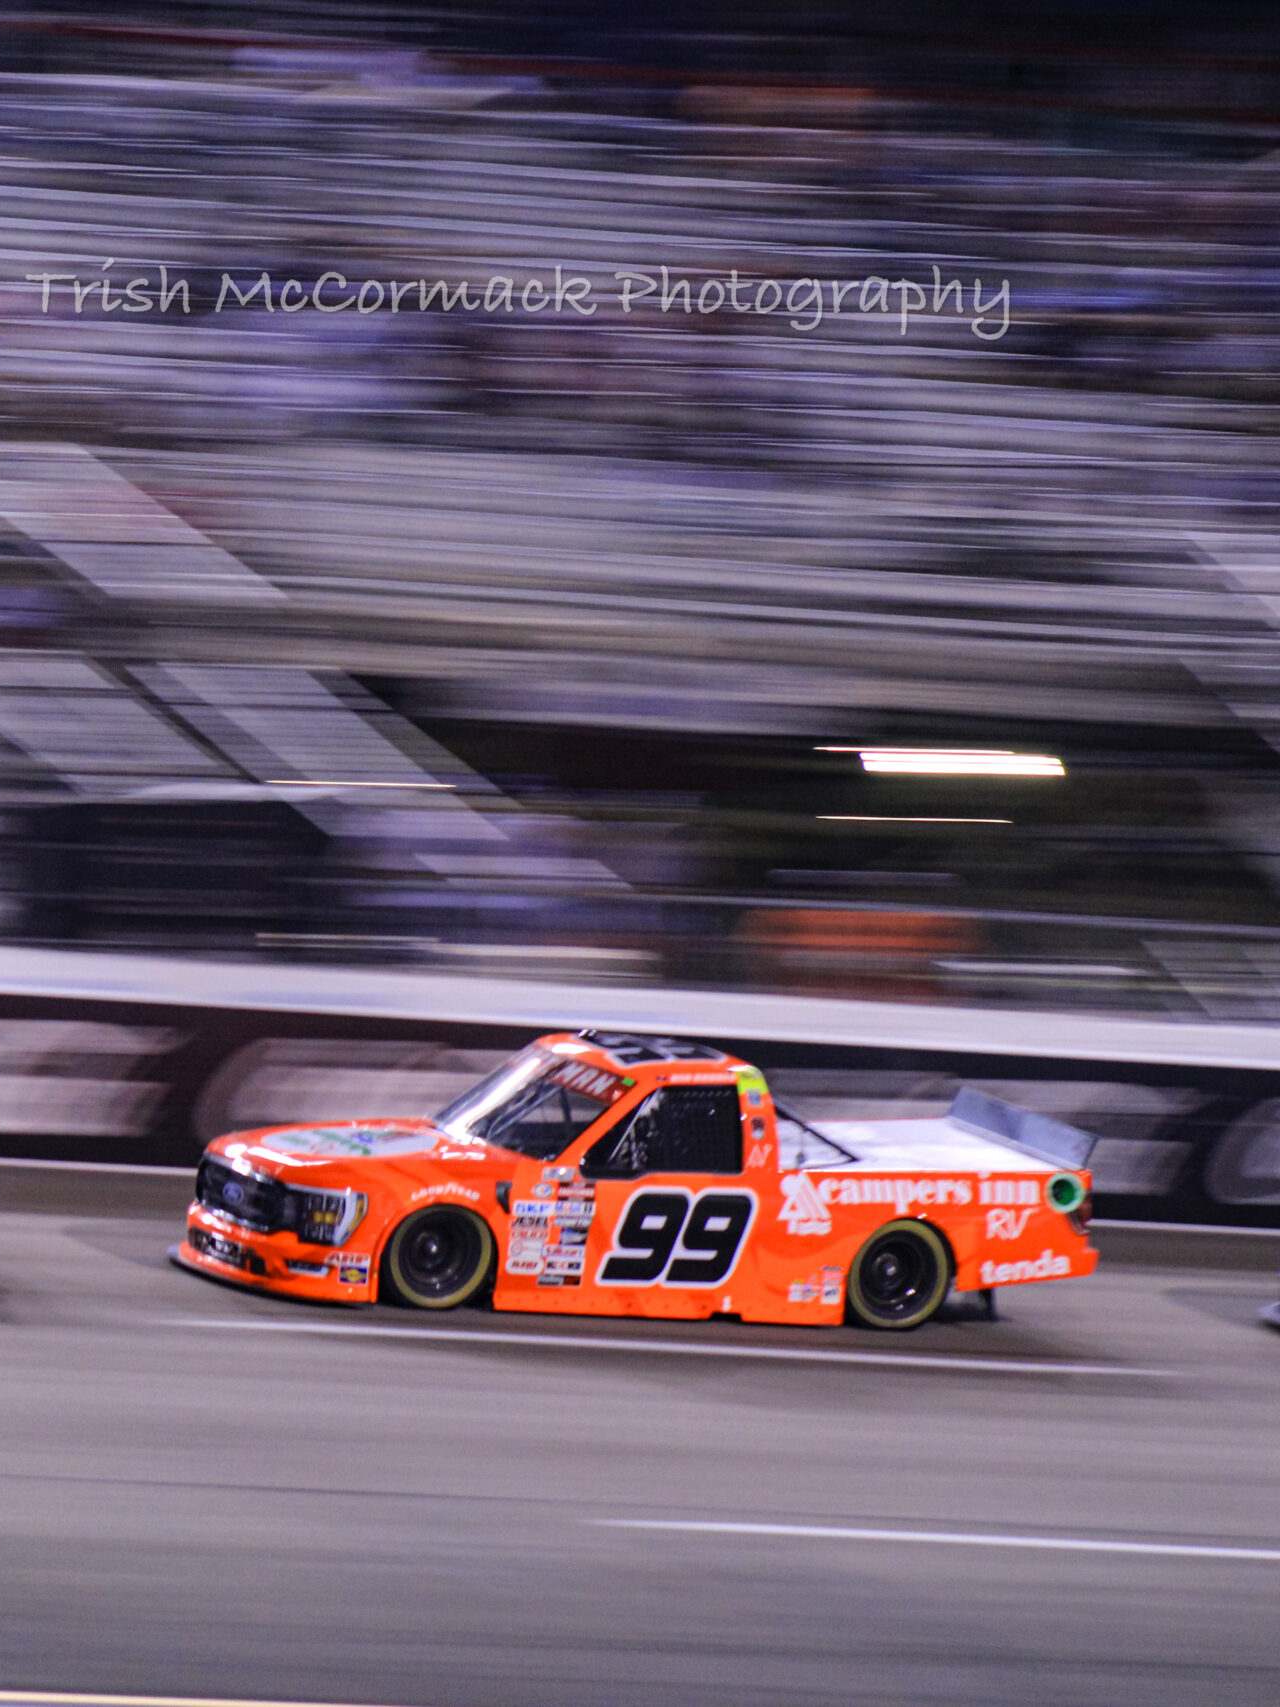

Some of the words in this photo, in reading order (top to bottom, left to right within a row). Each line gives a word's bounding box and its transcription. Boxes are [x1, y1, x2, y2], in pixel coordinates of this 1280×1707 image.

[977, 1171, 1041, 1205] inn
[595, 1185, 760, 1290] 99
[985, 1207, 1040, 1241] RV
[979, 1249, 1071, 1285] tenda
